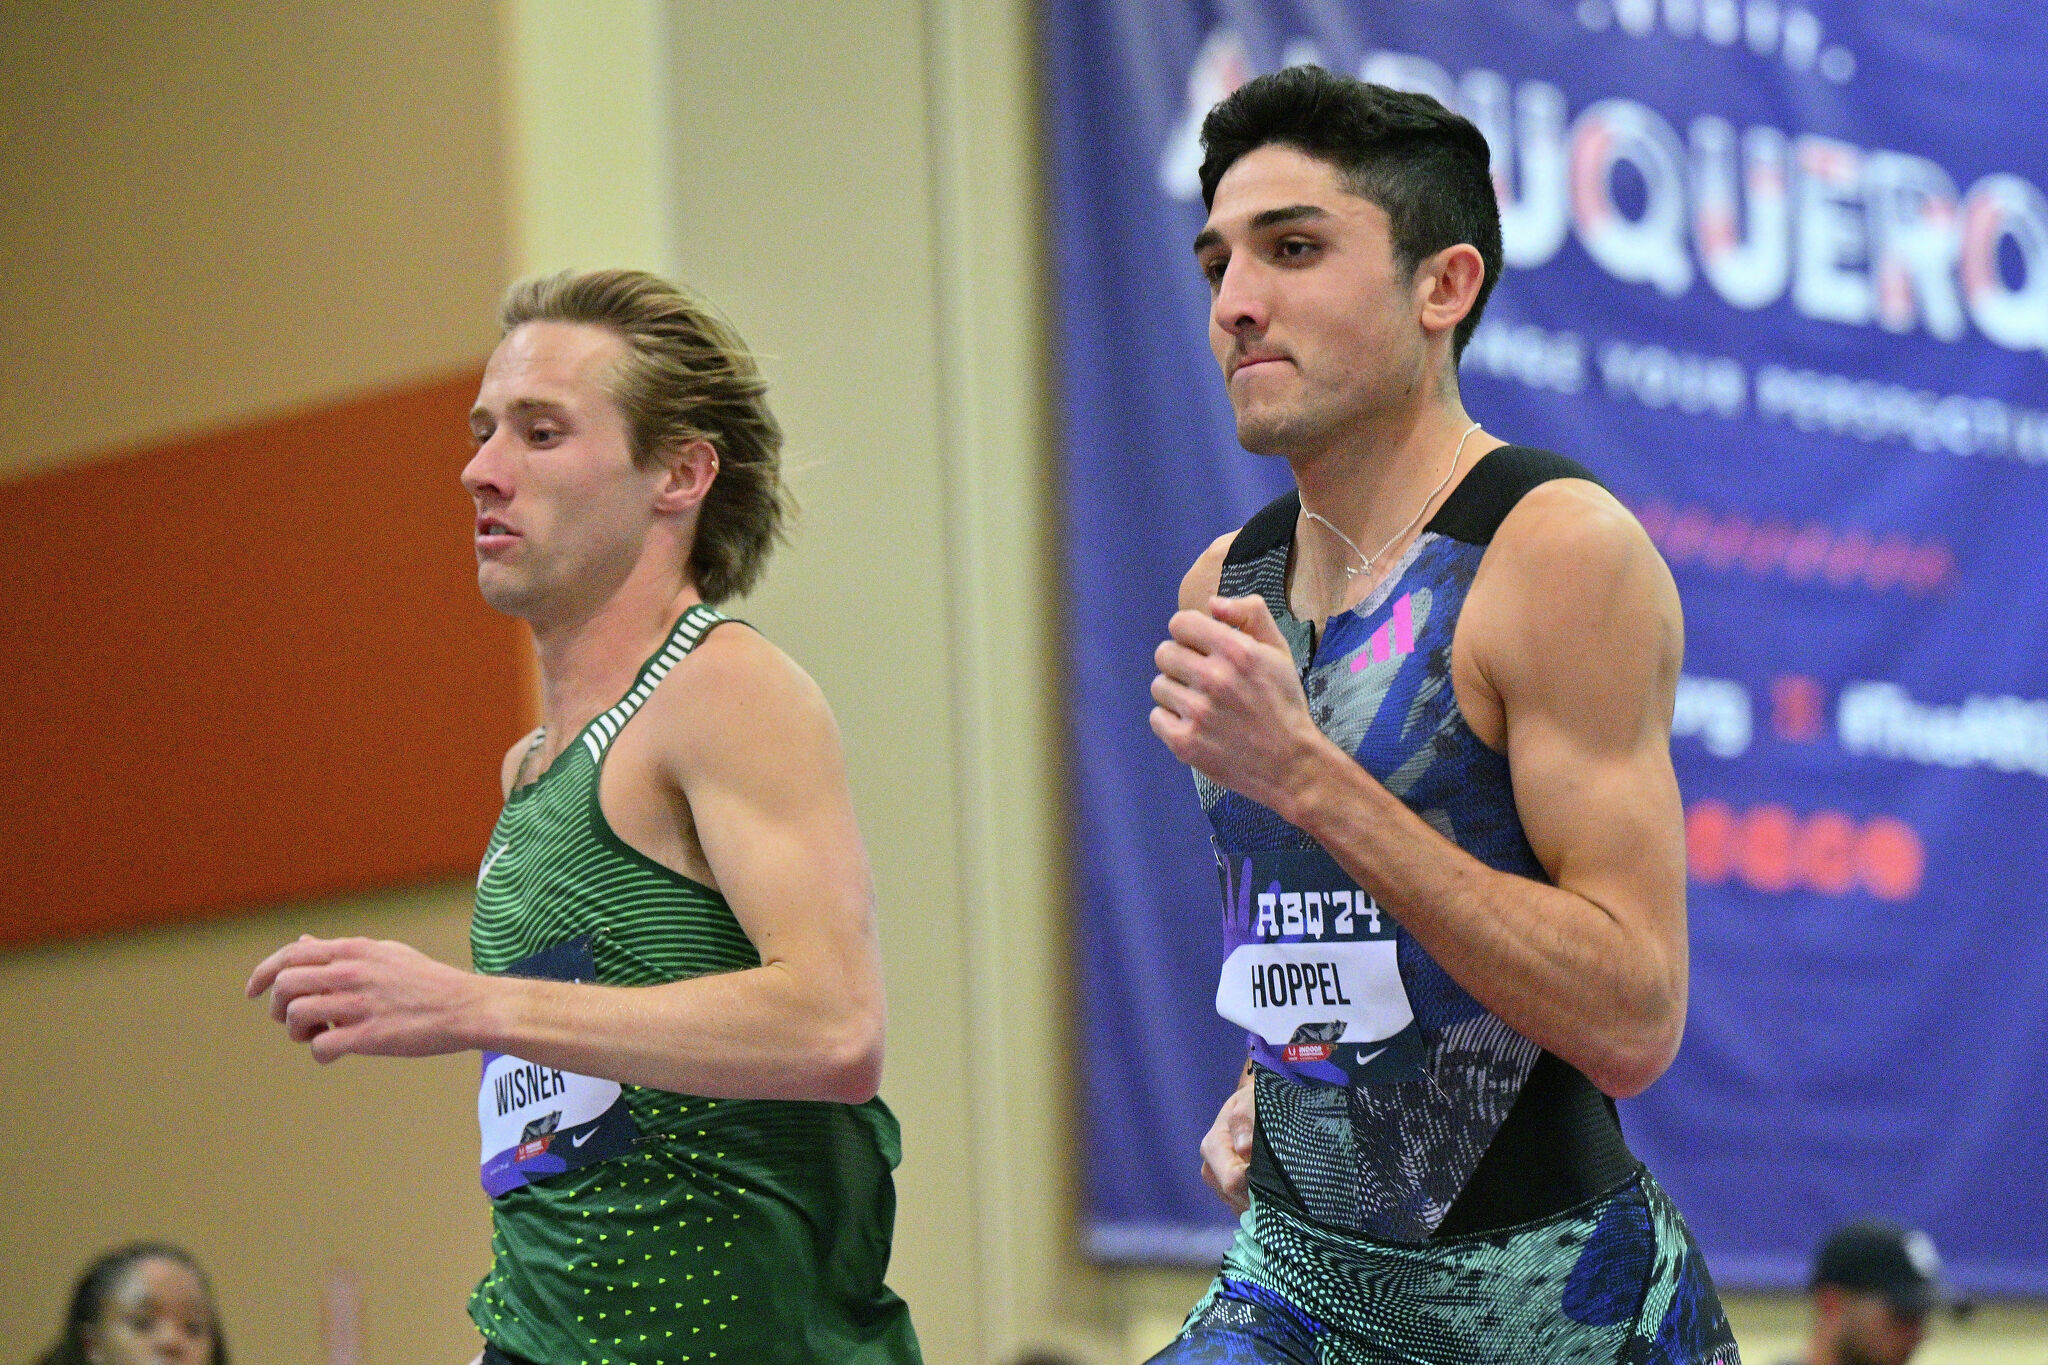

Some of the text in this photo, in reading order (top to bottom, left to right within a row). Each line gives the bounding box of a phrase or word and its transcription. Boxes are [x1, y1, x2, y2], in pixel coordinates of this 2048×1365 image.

[1257, 890, 1381, 939] ABQ'24
[1251, 962, 1351, 1009] HOPPEL
[494, 1065, 566, 1118] WISNER
